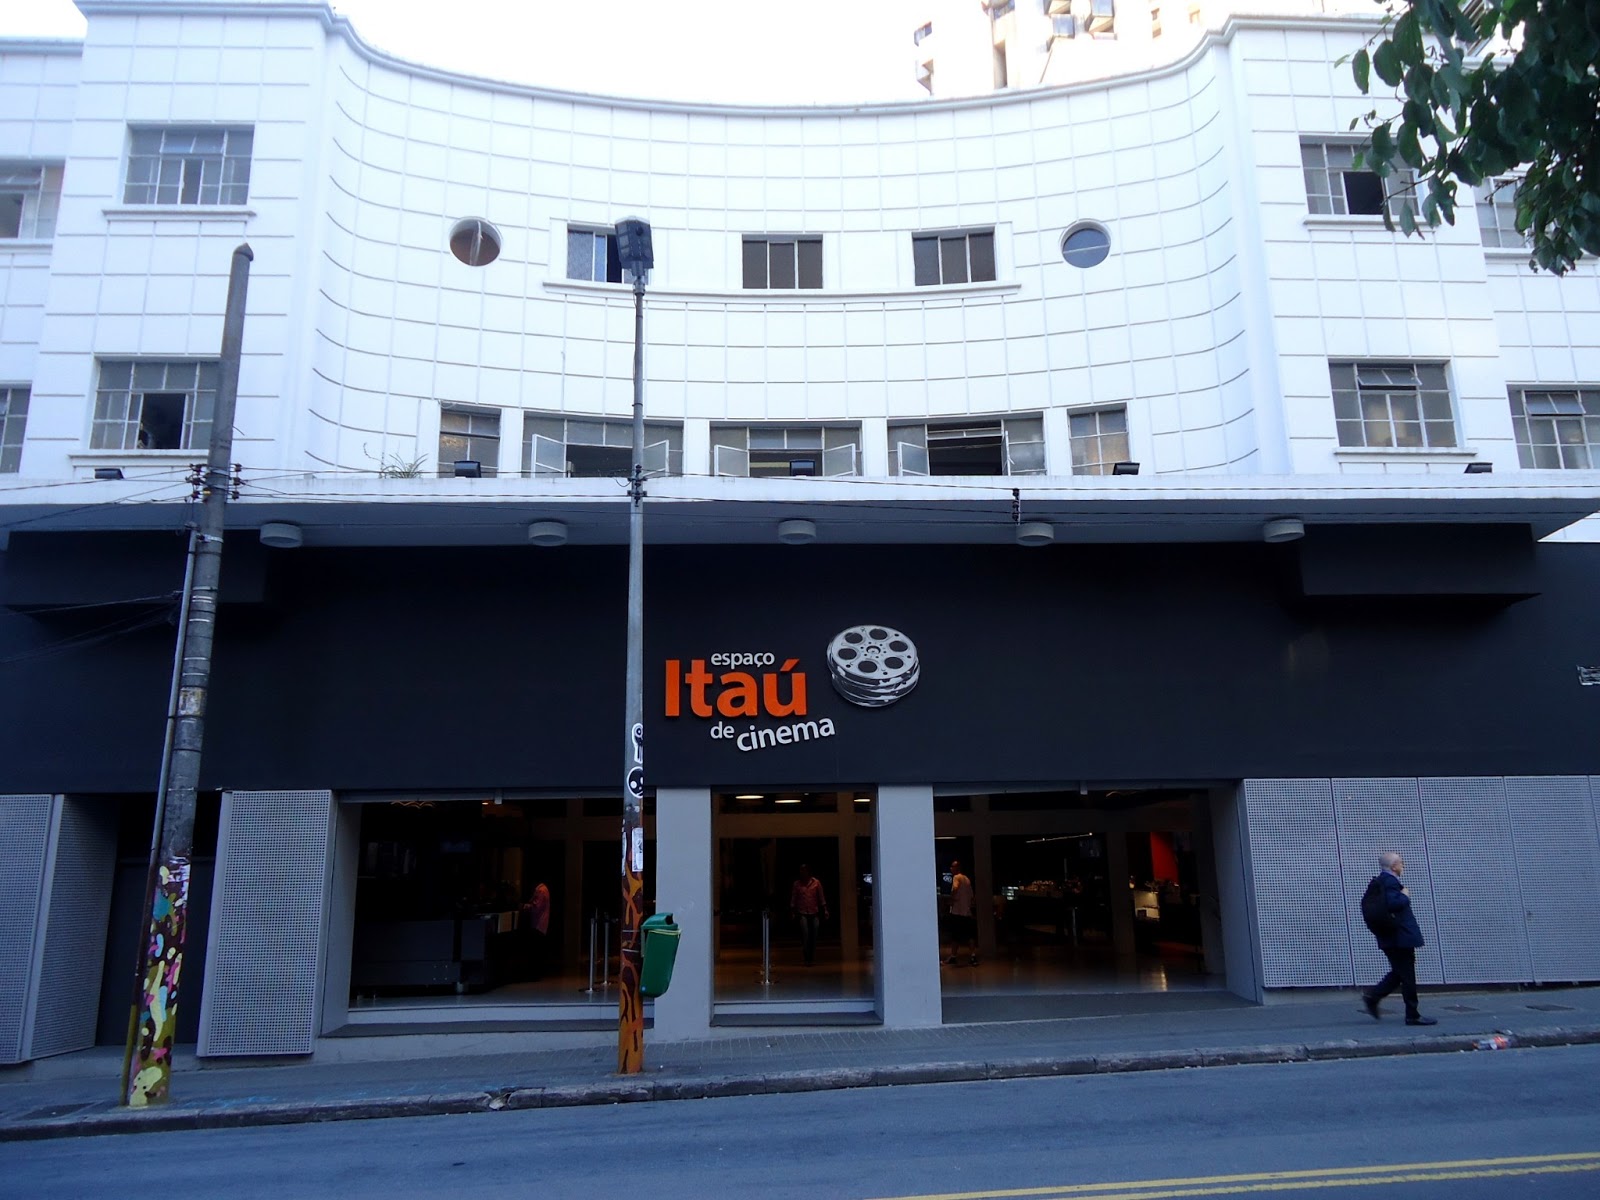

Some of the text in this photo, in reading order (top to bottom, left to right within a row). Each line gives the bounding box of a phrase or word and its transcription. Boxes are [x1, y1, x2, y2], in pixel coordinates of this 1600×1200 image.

[711, 652, 775, 669] espaço
[665, 659, 807, 717] Itaú
[711, 718, 836, 752] de cinema
